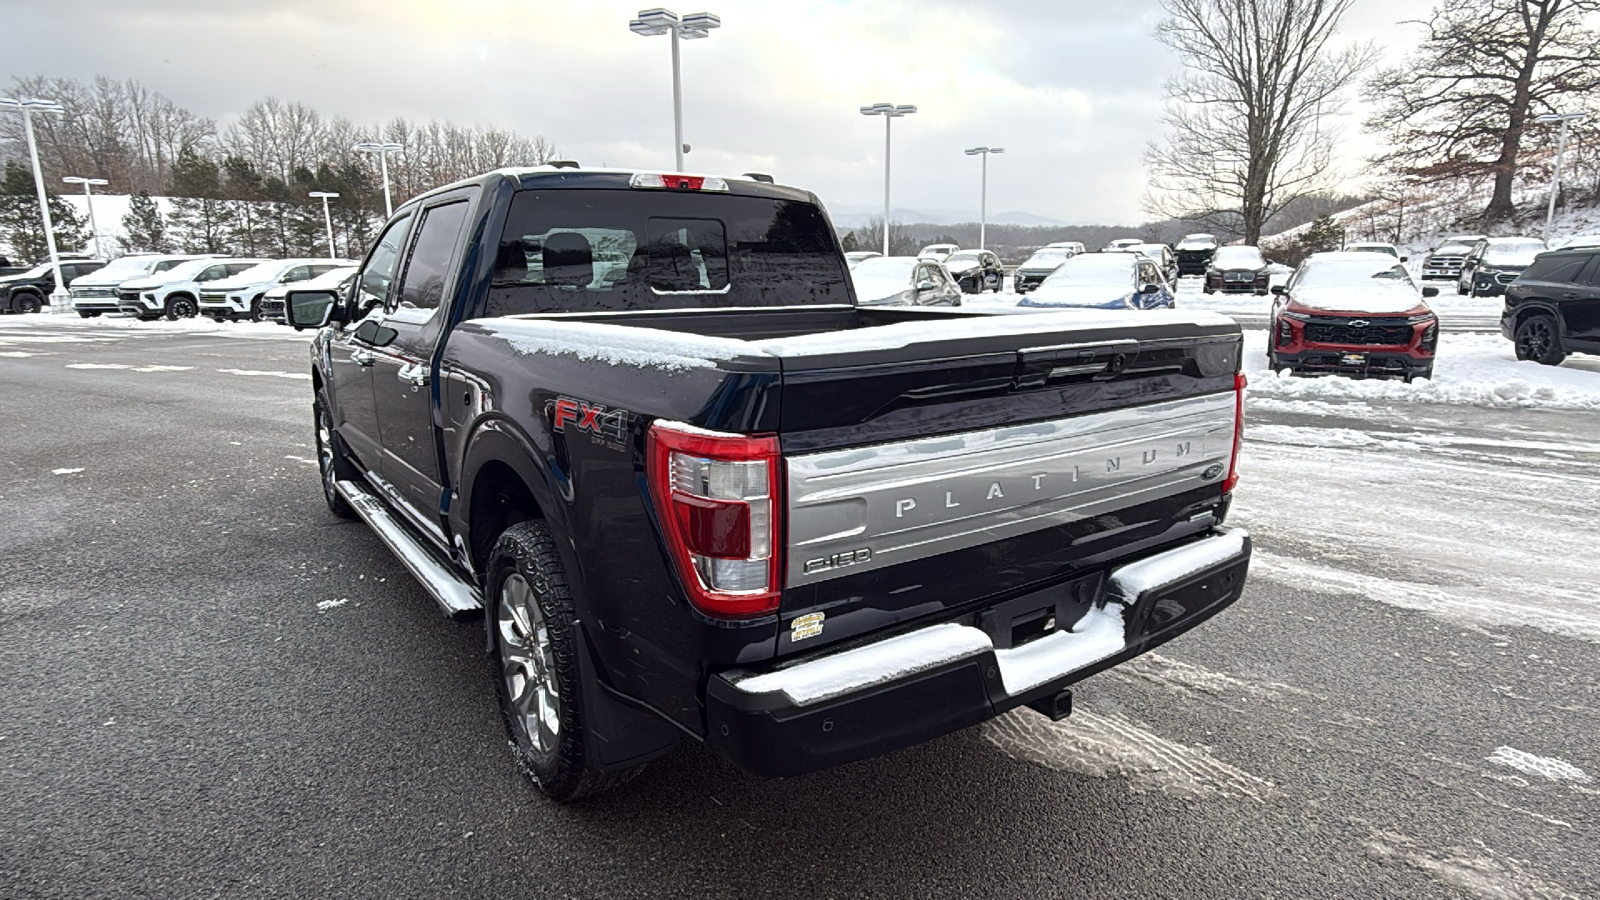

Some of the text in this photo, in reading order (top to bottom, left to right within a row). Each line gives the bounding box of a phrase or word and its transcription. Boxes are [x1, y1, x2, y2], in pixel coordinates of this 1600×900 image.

[553, 395, 628, 444] FX4
[896, 441, 1191, 518] PLATINUM
[803, 547, 871, 575] F-150
